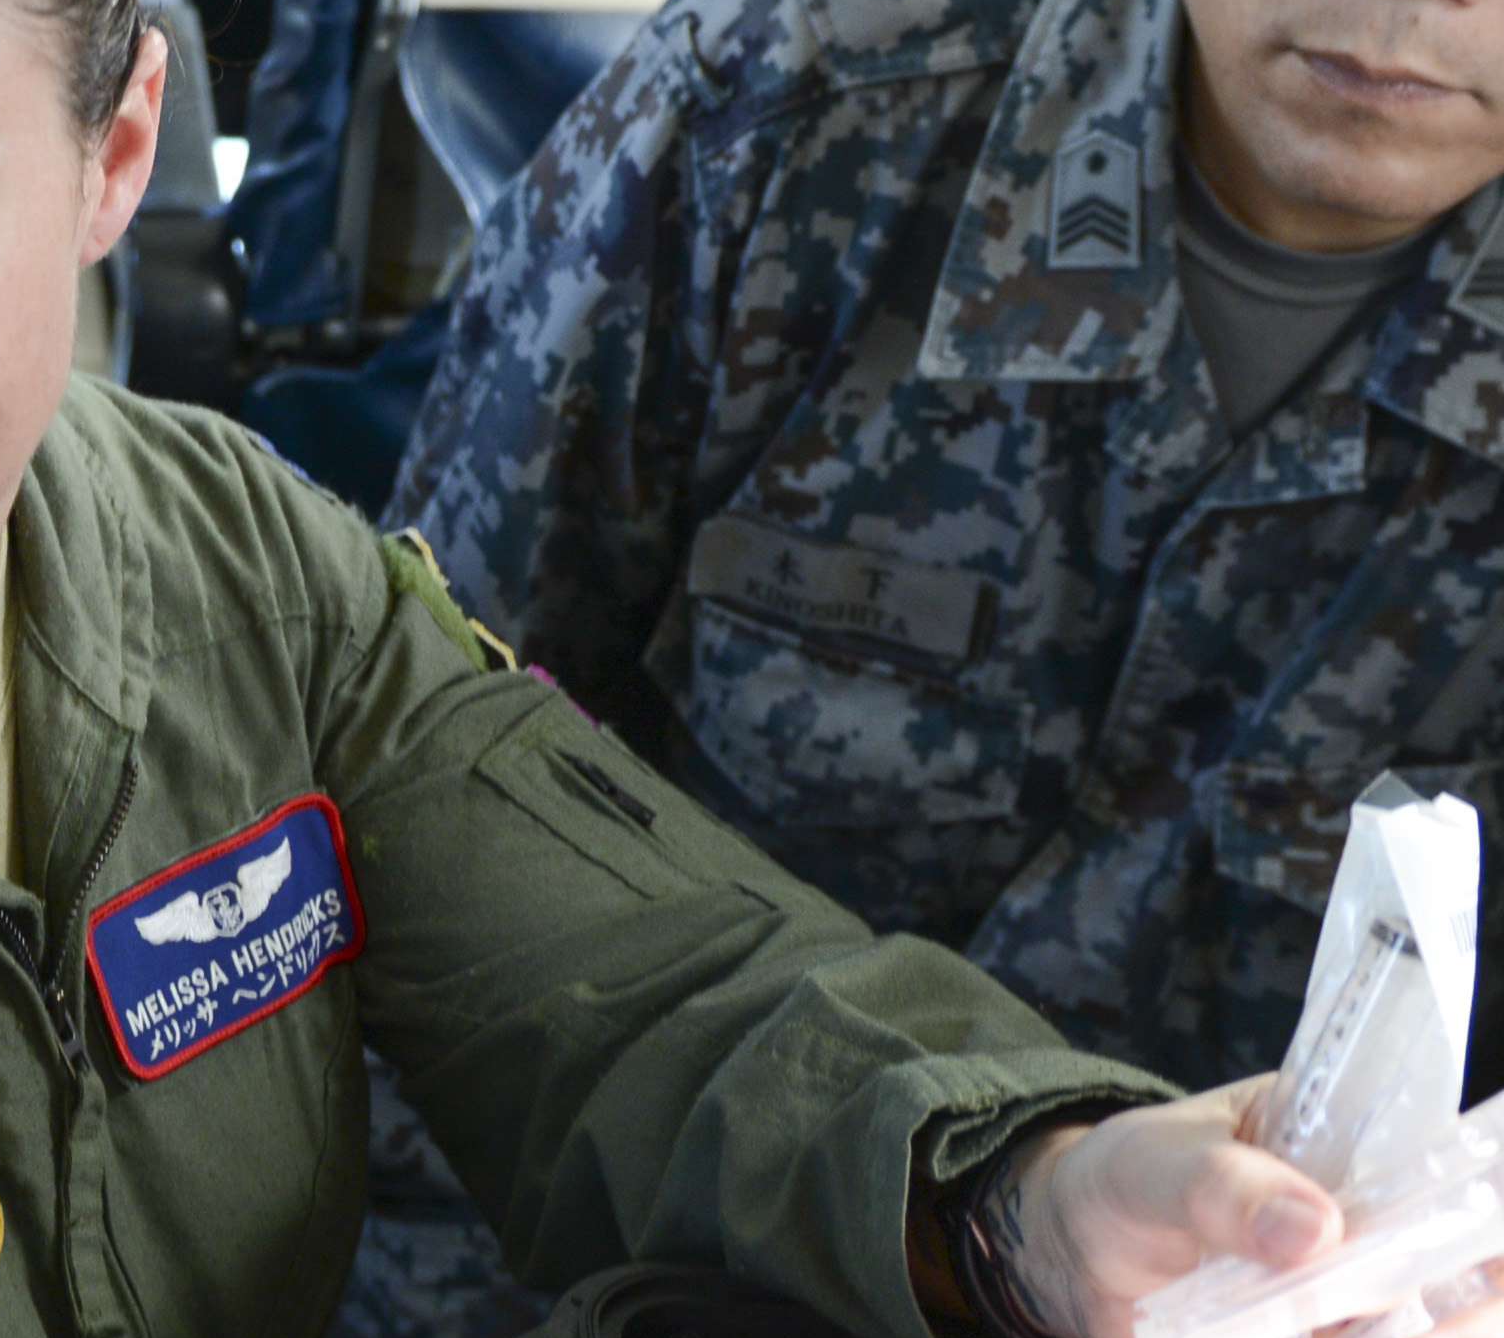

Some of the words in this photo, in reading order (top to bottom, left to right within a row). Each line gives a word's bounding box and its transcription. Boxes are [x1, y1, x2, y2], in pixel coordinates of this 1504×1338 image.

[745, 574, 909, 637] KINOSHITA
[126, 959, 230, 1038] MELISSA
[231, 887, 342, 978] HENDRICKS
[150, 997, 219, 1062] メリッサ
[232, 921, 346, 1005] ヘンドリックス
